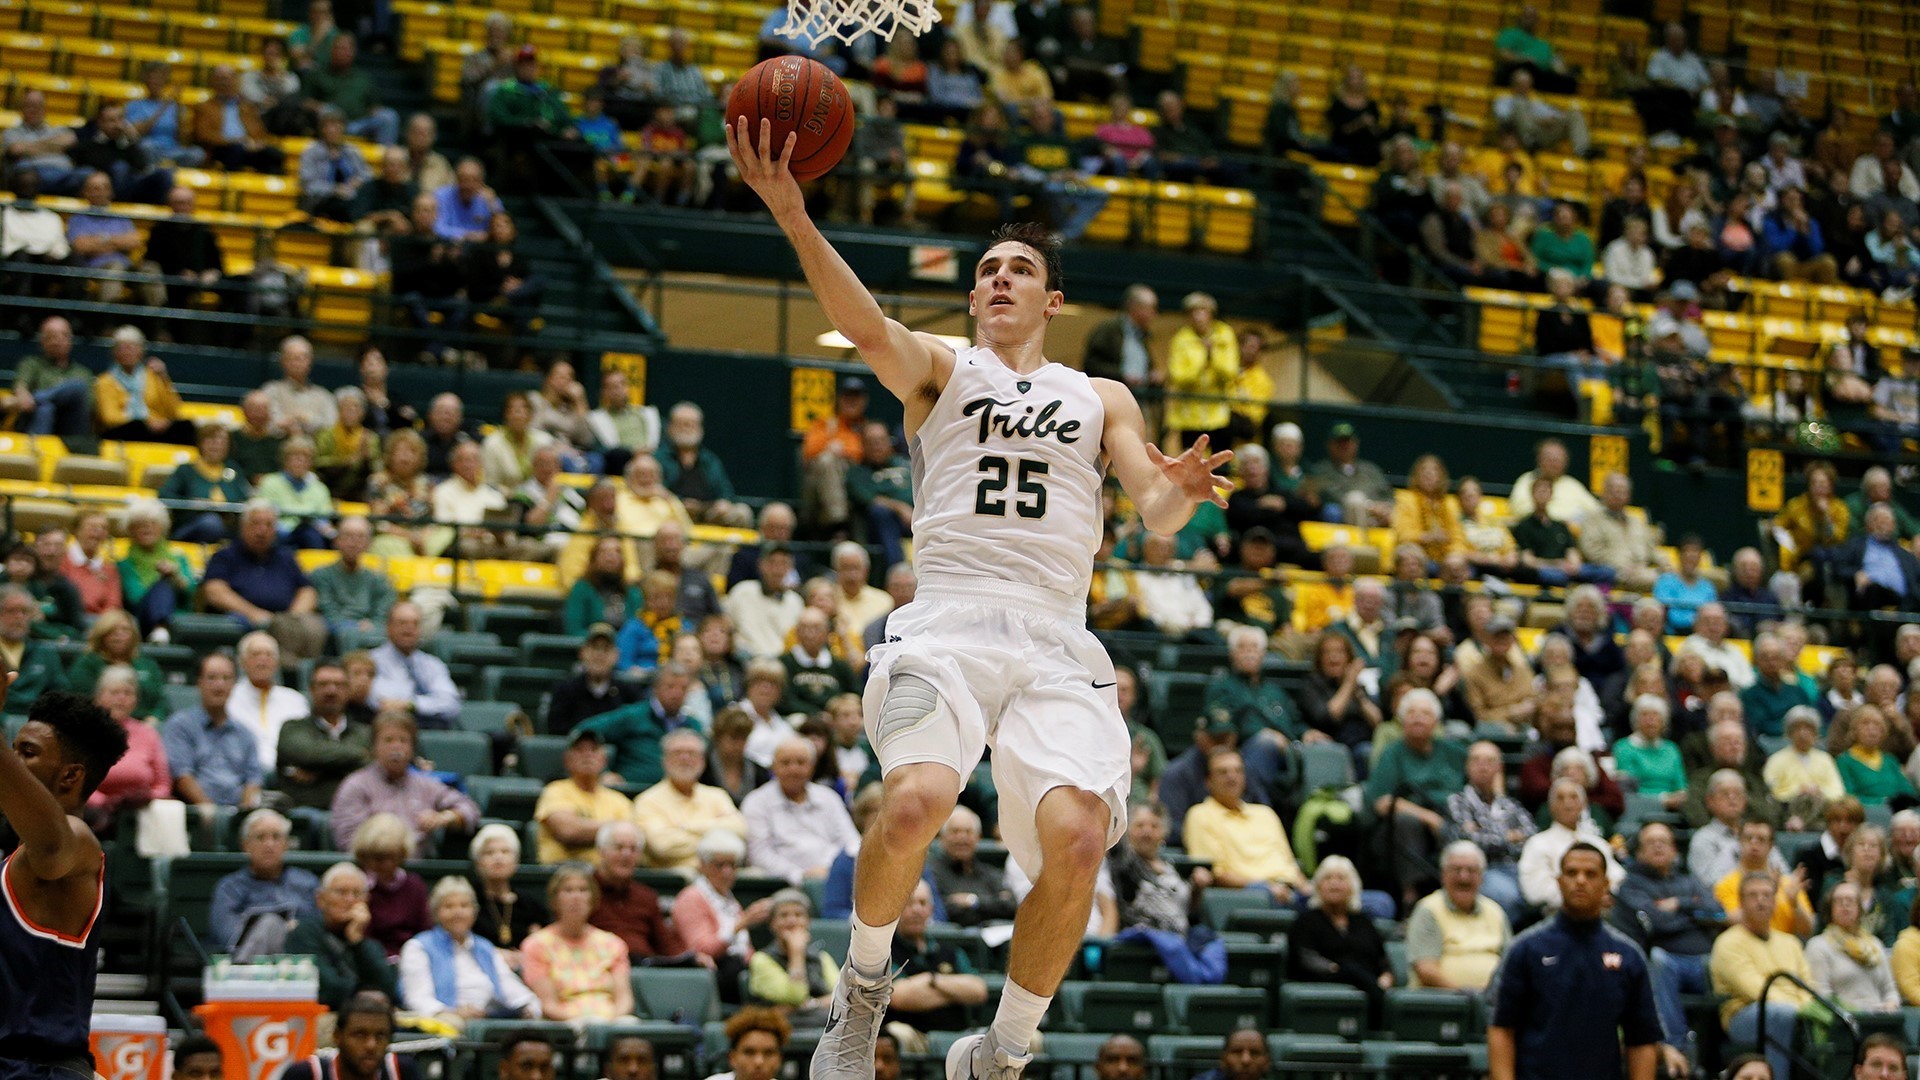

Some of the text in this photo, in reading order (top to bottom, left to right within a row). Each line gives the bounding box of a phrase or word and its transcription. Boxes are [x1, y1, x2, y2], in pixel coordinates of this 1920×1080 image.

[804, 69, 835, 136] LDING
[962, 397, 1081, 444] Tribe
[974, 454, 1050, 520] 25
[116, 1042, 144, 1073] G
[254, 1021, 289, 1060] G
